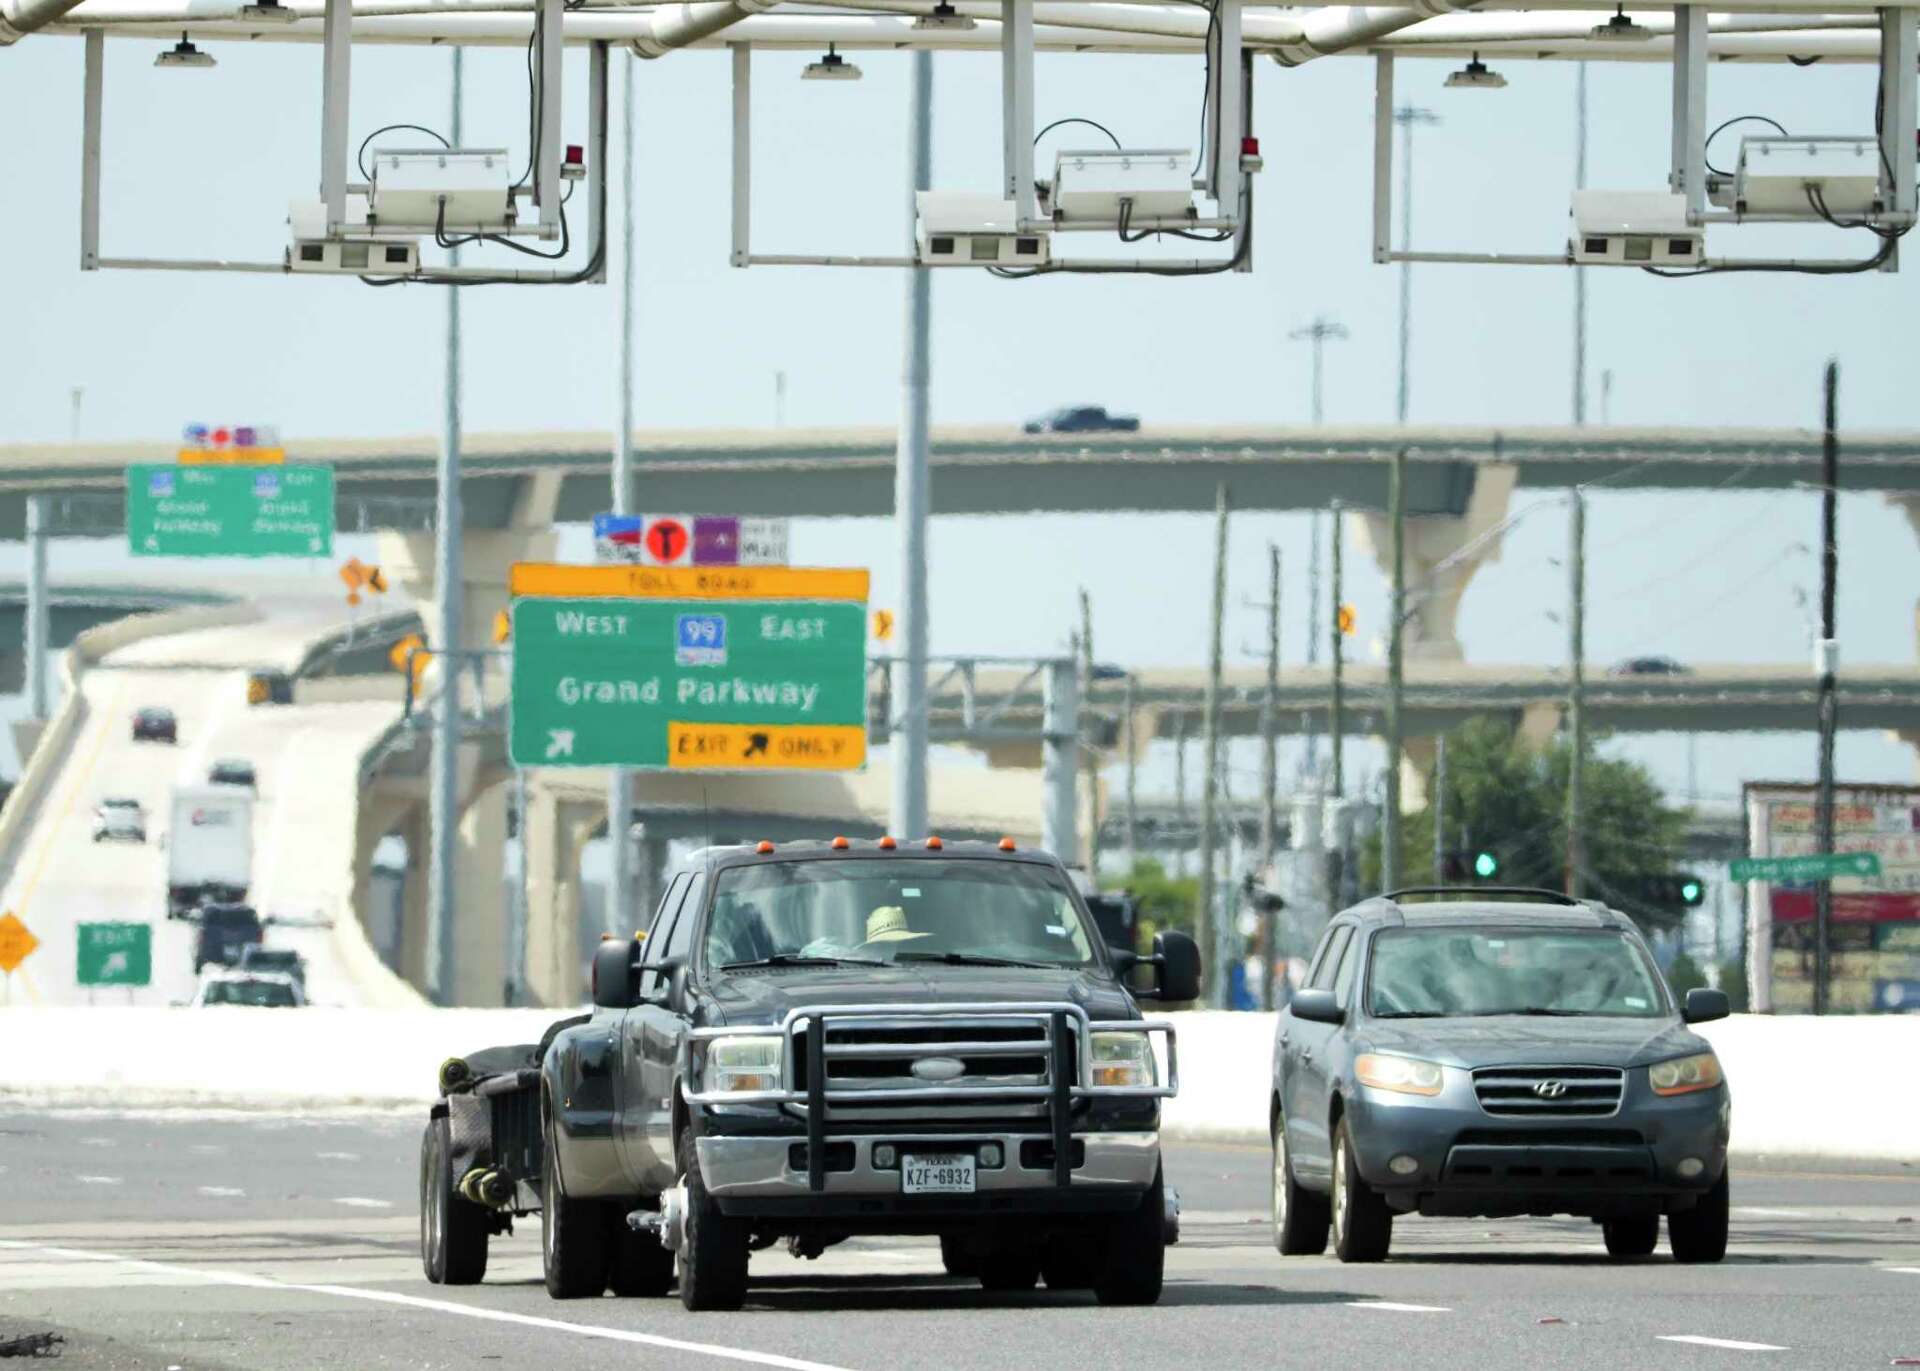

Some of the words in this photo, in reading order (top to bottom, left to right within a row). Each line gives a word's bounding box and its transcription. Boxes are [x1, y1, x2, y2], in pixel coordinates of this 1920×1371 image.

[629, 572, 677, 591] TOLL
[686, 619, 717, 642] 99
[760, 614, 828, 640] EAST
[556, 677, 661, 705] Grand
[677, 678, 821, 712] Parkway
[677, 732, 730, 755] EXIT
[778, 735, 847, 758] ONLY
